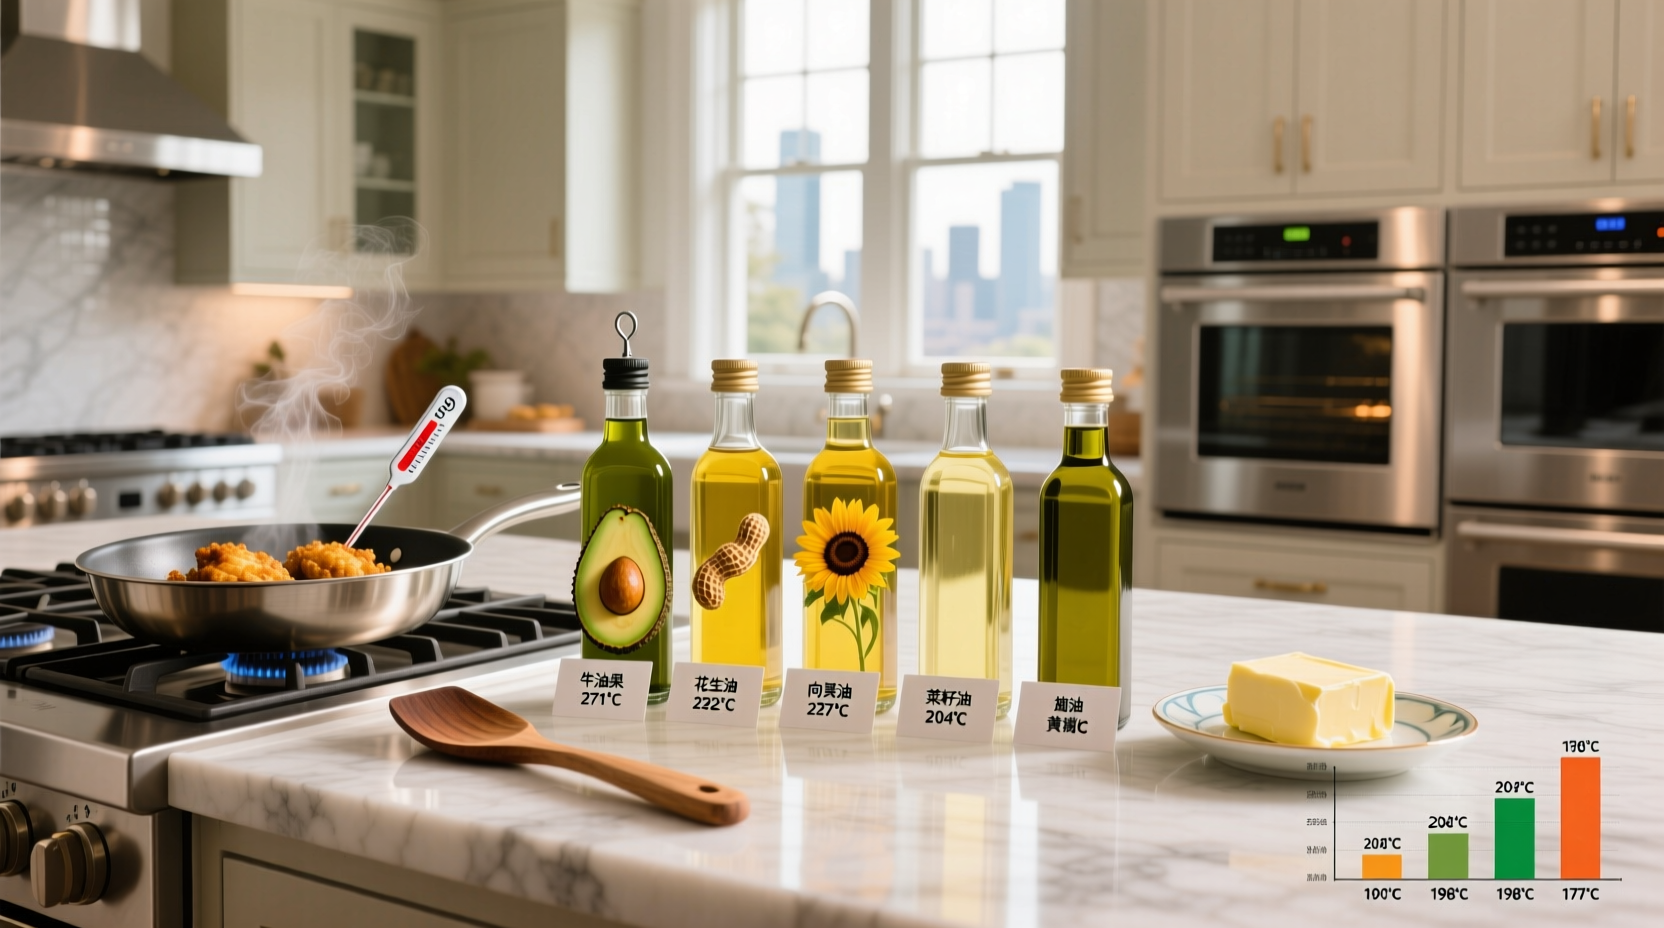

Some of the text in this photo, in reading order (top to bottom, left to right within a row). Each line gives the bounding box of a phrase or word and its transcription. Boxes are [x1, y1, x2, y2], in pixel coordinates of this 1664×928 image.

[580, 671, 624, 689] 牛油果
[694, 675, 738, 694] 花生油
[580, 691, 622, 708] 271°C
[806, 701, 850, 718] 227°C
[924, 709, 968, 727] 204°C
